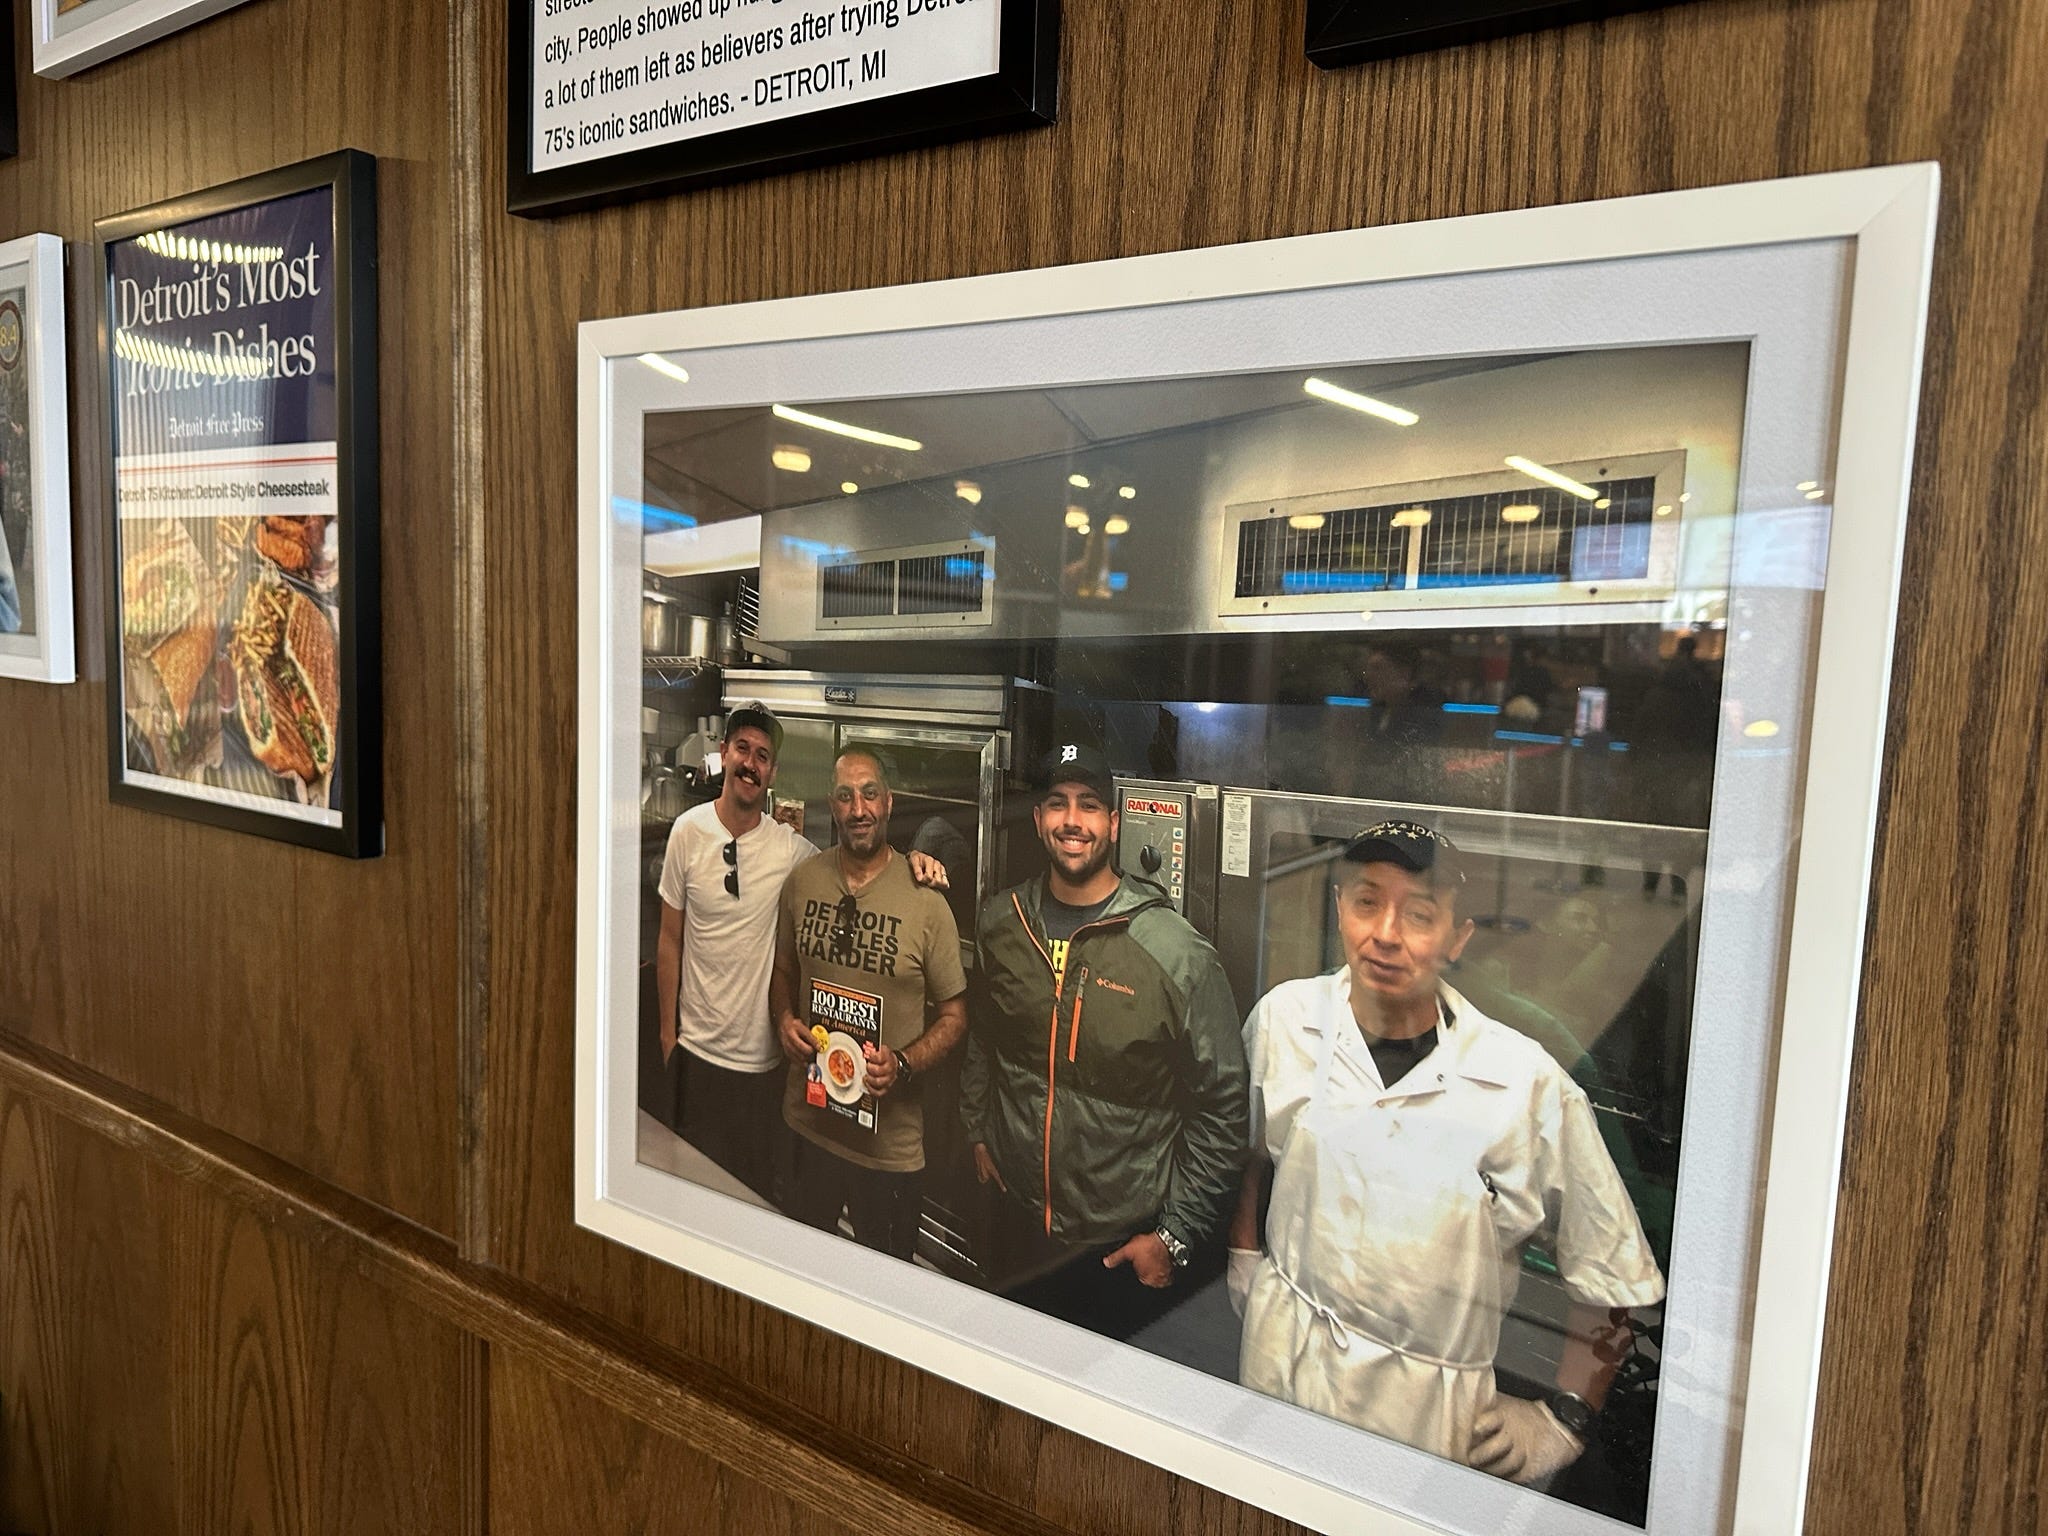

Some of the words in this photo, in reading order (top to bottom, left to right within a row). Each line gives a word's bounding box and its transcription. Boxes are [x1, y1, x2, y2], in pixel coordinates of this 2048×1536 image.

[545, 35, 572, 64] city.
[578, 15, 632, 53] People
[637, 0, 702, 36] showed
[709, 0, 731, 19] up
[545, 88, 554, 109] a
[558, 80, 577, 105] lot
[581, 70, 596, 99] of
[600, 64, 639, 94] them
[645, 51, 670, 82] left
[675, 50, 696, 75] as
[702, 26, 783, 68] believers
[790, 11, 836, 46] after
[841, 0, 900, 36] trying
[545, 126, 575, 154] 75's
[579, 113, 625, 146] iconic
[630, 92, 735, 135] sandwiches.
[754, 57, 853, 107] DETROIT,
[861, 49, 887, 82] MI
[120, 261, 231, 330] Detroit's
[237, 241, 321, 309] Most
[212, 323, 317, 387] Dishes
[169, 414, 205, 438] Detroit
[205, 412, 231, 436] Free
[232, 411, 265, 437] Press
[196, 482, 229, 500] Detroit
[230, 482, 256, 502] Style
[257, 478, 330, 497] Cheesesteak
[1127, 799, 1181, 816] RATIONAL
[801, 918, 899, 956] HUSLES
[799, 935, 896, 978] HARDER
[812, 988, 836, 1009] 100
[838, 995, 878, 1021] BEST
[812, 1002, 878, 1031] RESTAURANTS
[832, 1020, 866, 1037] America
